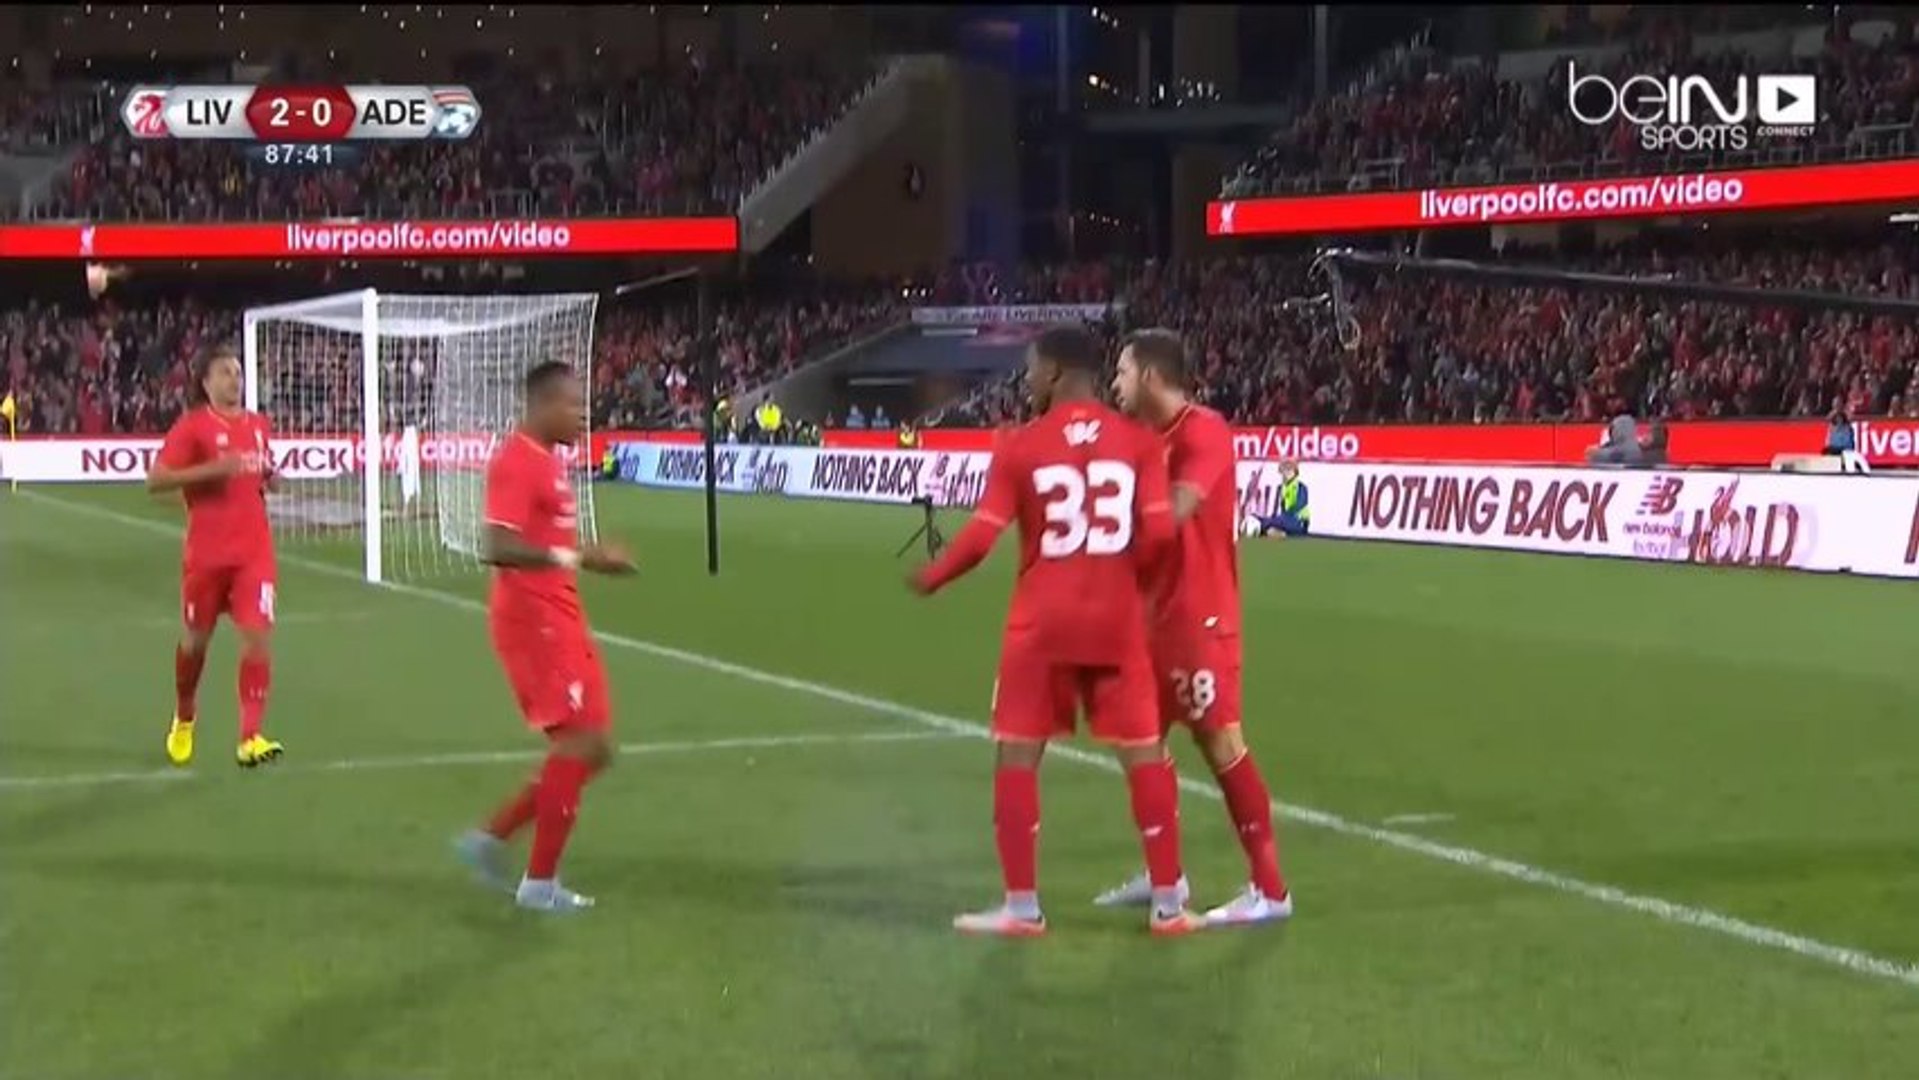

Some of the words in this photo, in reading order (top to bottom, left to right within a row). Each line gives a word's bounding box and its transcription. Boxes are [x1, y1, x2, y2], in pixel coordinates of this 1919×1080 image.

[1419, 173, 1744, 221] liverpoolfc.com/video
[286, 222, 570, 254] liverpoolfc.com/video
[810, 453, 877, 491] NOTHING
[876, 455, 924, 496] BACK
[1032, 459, 1135, 559] 33
[1348, 474, 1500, 535] NOTHING
[1503, 479, 1619, 542] BACK
[1170, 669, 1215, 706] 28
